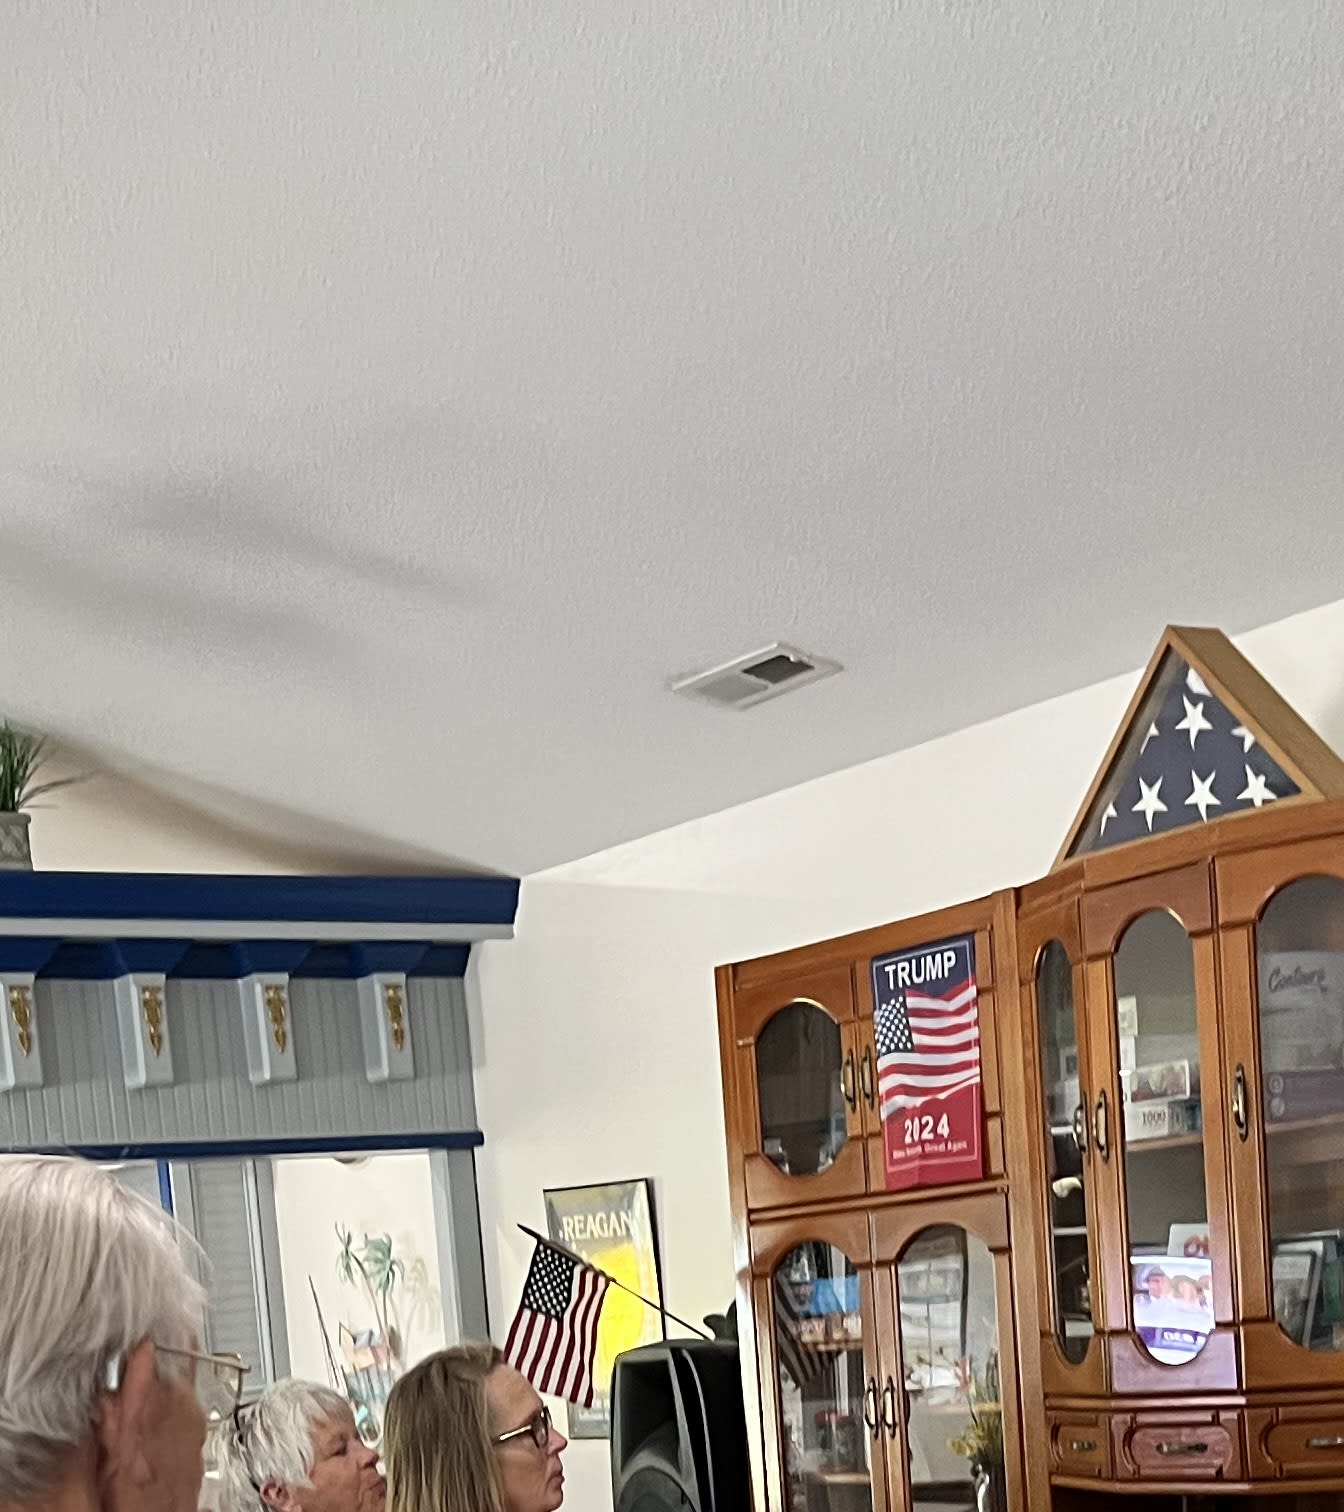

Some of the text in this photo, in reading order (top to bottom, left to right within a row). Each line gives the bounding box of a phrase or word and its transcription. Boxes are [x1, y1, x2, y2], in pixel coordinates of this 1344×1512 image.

[885, 950, 956, 990] TRUMP
[904, 1112, 950, 1145] 2024
[562, 1209, 637, 1242] REAGAN
